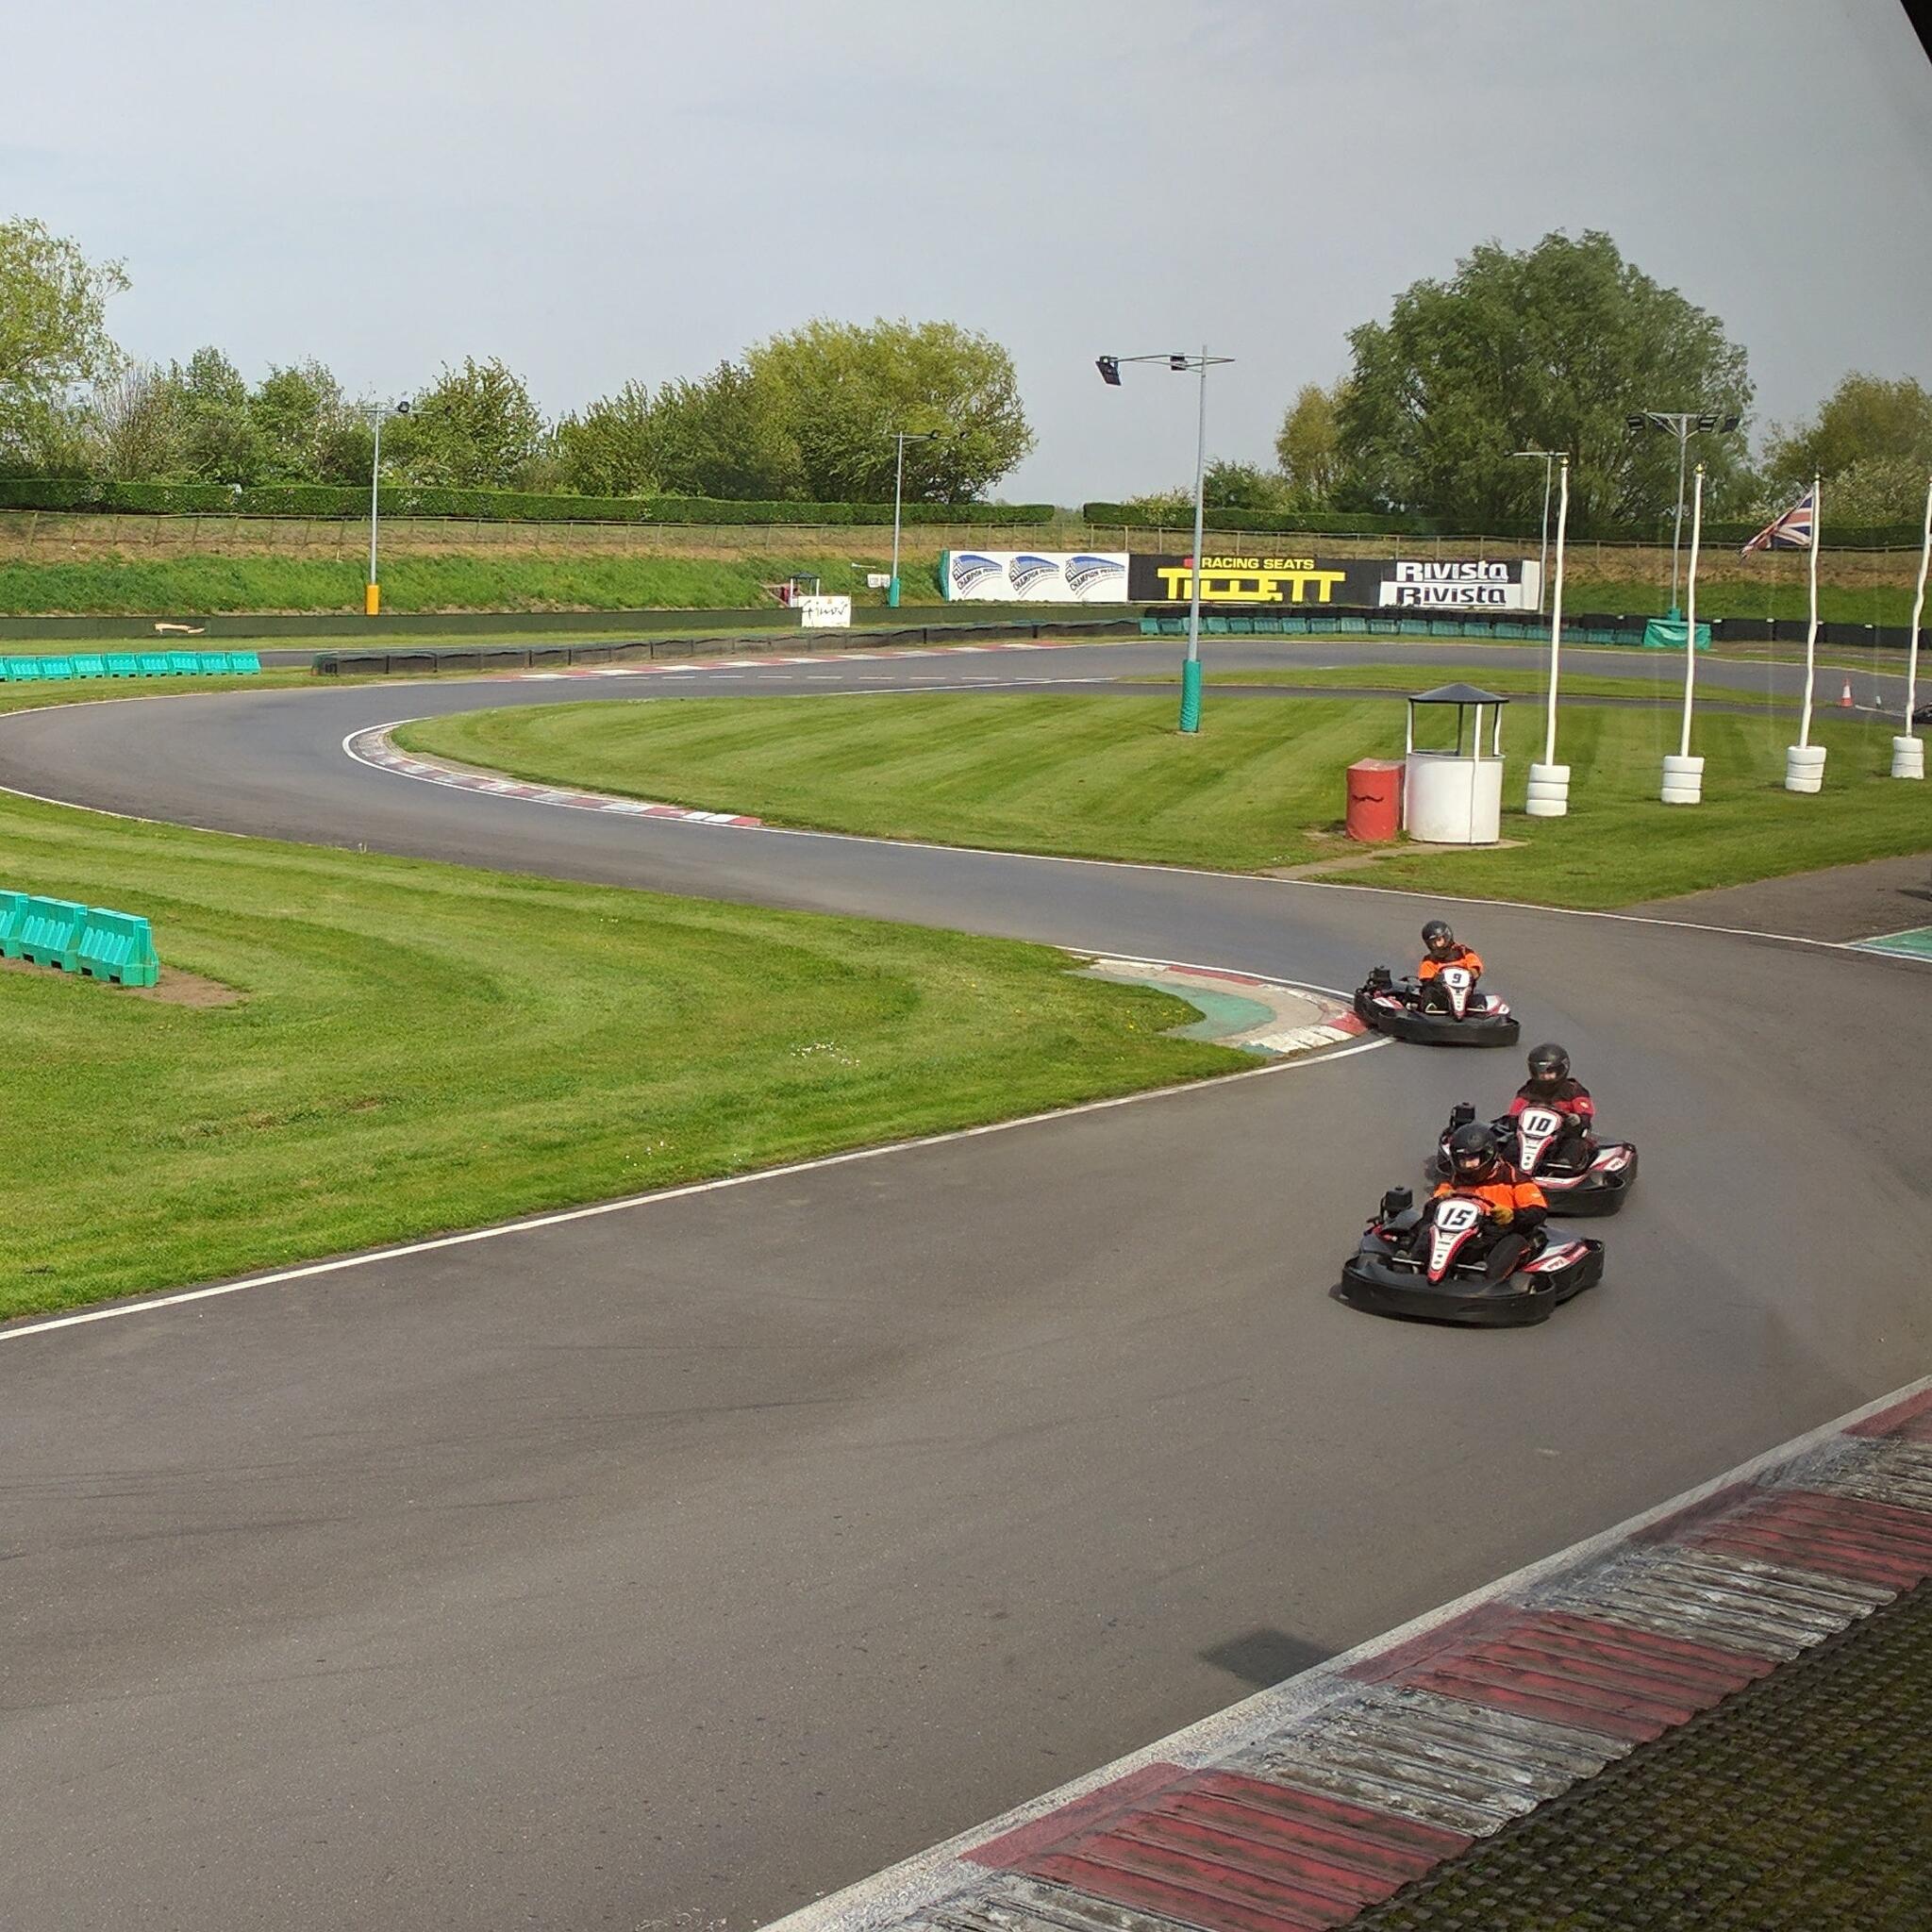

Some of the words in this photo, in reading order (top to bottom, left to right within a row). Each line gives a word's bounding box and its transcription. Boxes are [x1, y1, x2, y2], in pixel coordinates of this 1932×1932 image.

[1201, 558, 1259, 570] RACING
[1263, 558, 1314, 570] SEATS
[1452, 973, 1462, 984] 9
[1526, 1115, 1553, 1132] 10
[1441, 1207, 1474, 1226] 15
